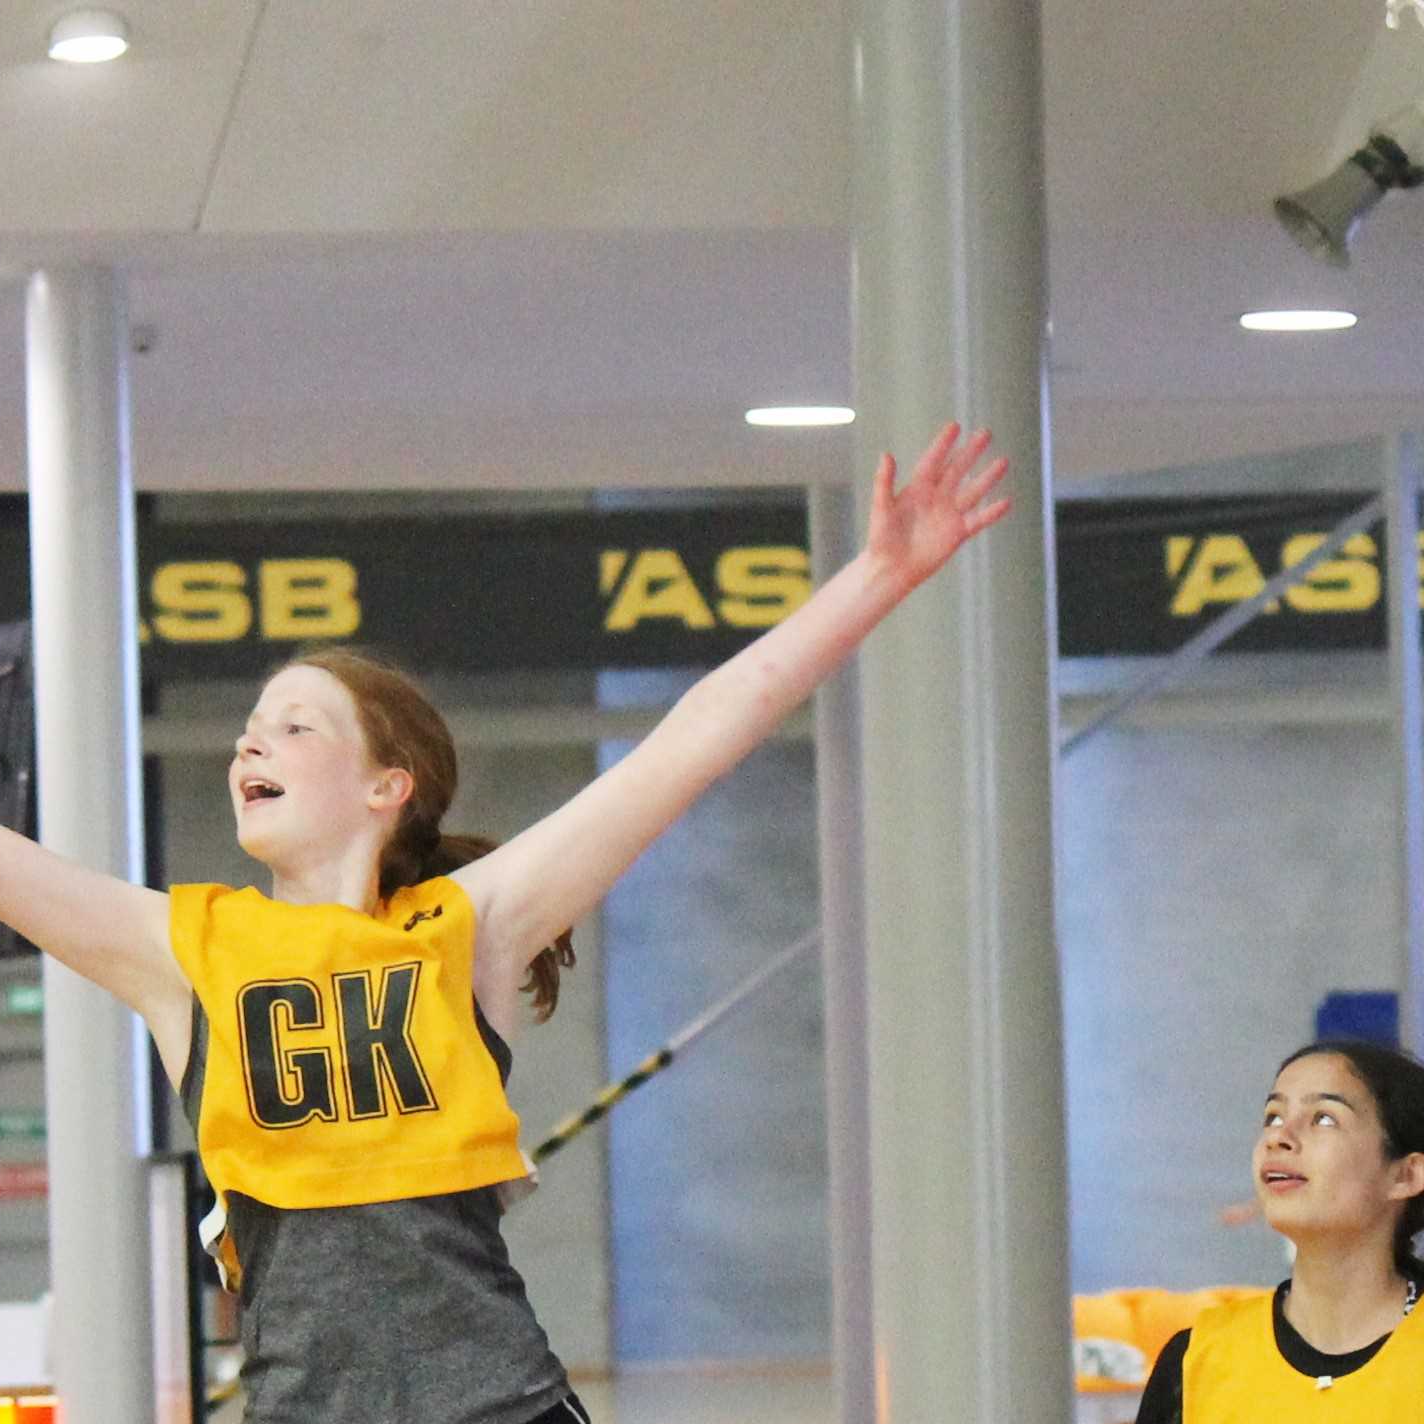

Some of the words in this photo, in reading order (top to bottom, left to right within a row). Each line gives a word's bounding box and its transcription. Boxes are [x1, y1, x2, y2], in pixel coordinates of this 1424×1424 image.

[139, 557, 362, 642] SB
[598, 546, 813, 632] AS
[235, 960, 440, 1131] GK
